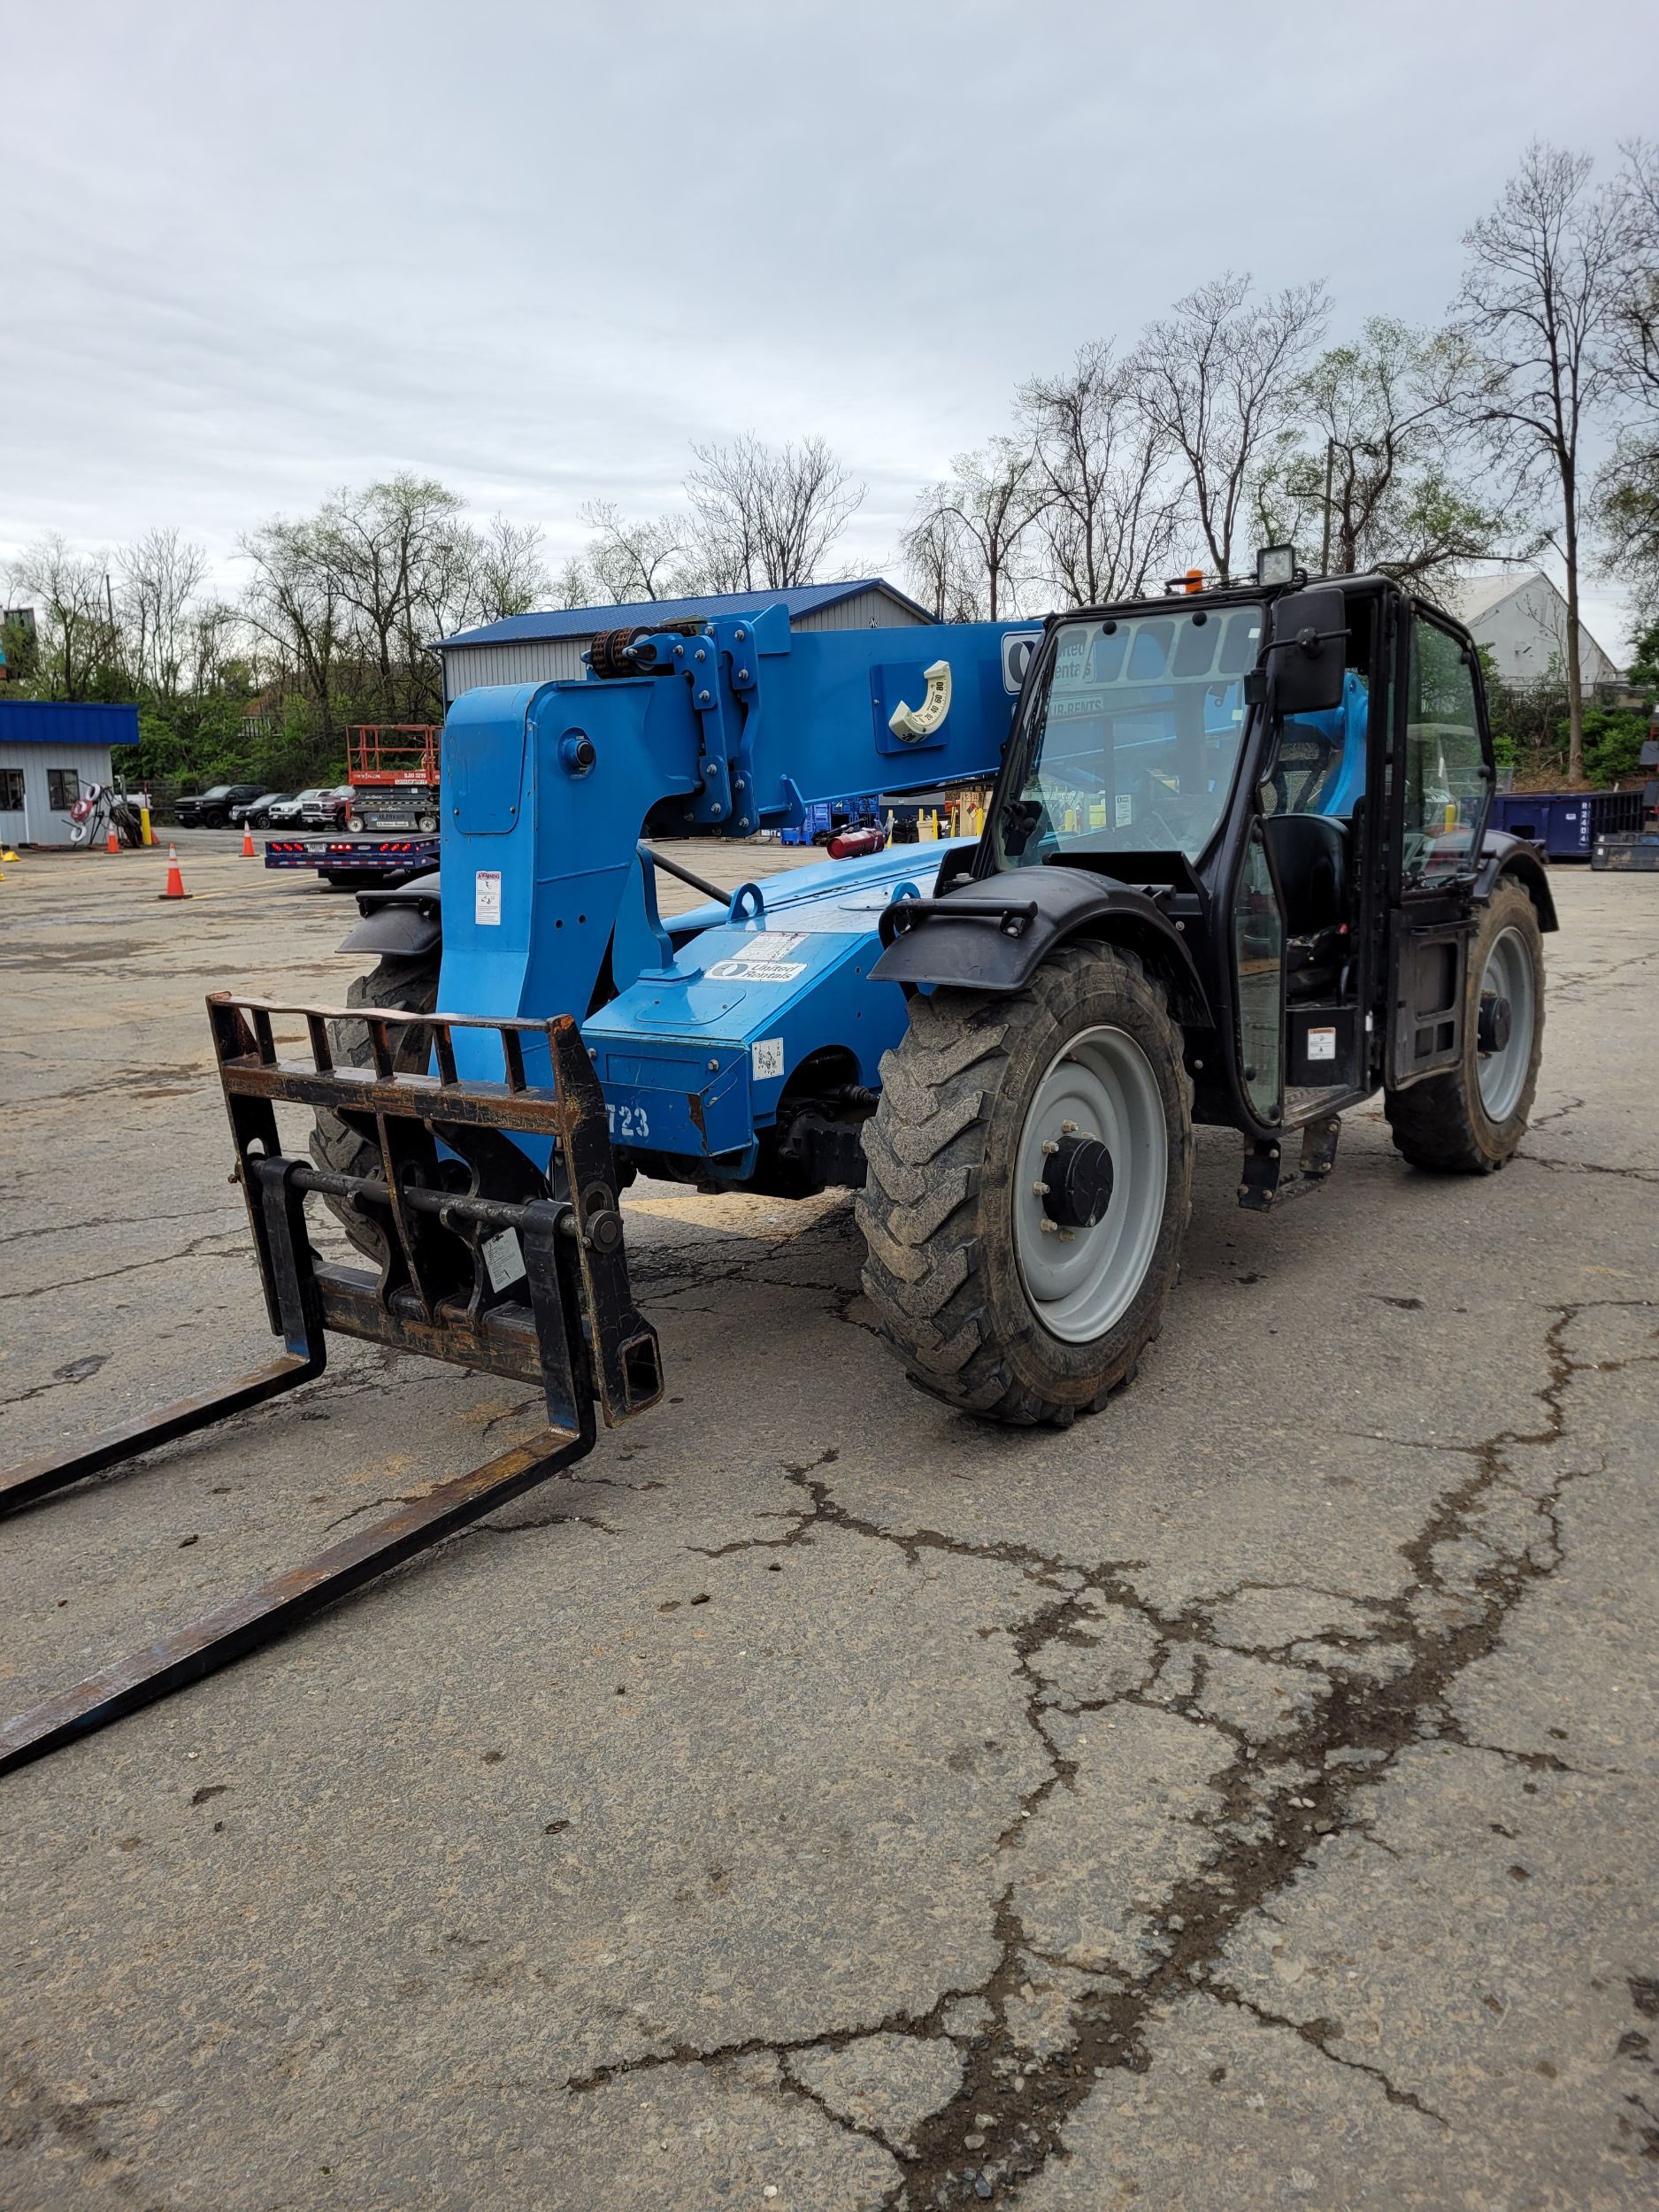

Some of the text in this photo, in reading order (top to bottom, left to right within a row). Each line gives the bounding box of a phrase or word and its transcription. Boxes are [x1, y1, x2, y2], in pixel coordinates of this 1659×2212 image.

[935, 681, 944, 691] 80
[934, 694, 943, 704] 60
[930, 705, 940, 714] 40
[751, 964, 800, 973] United
